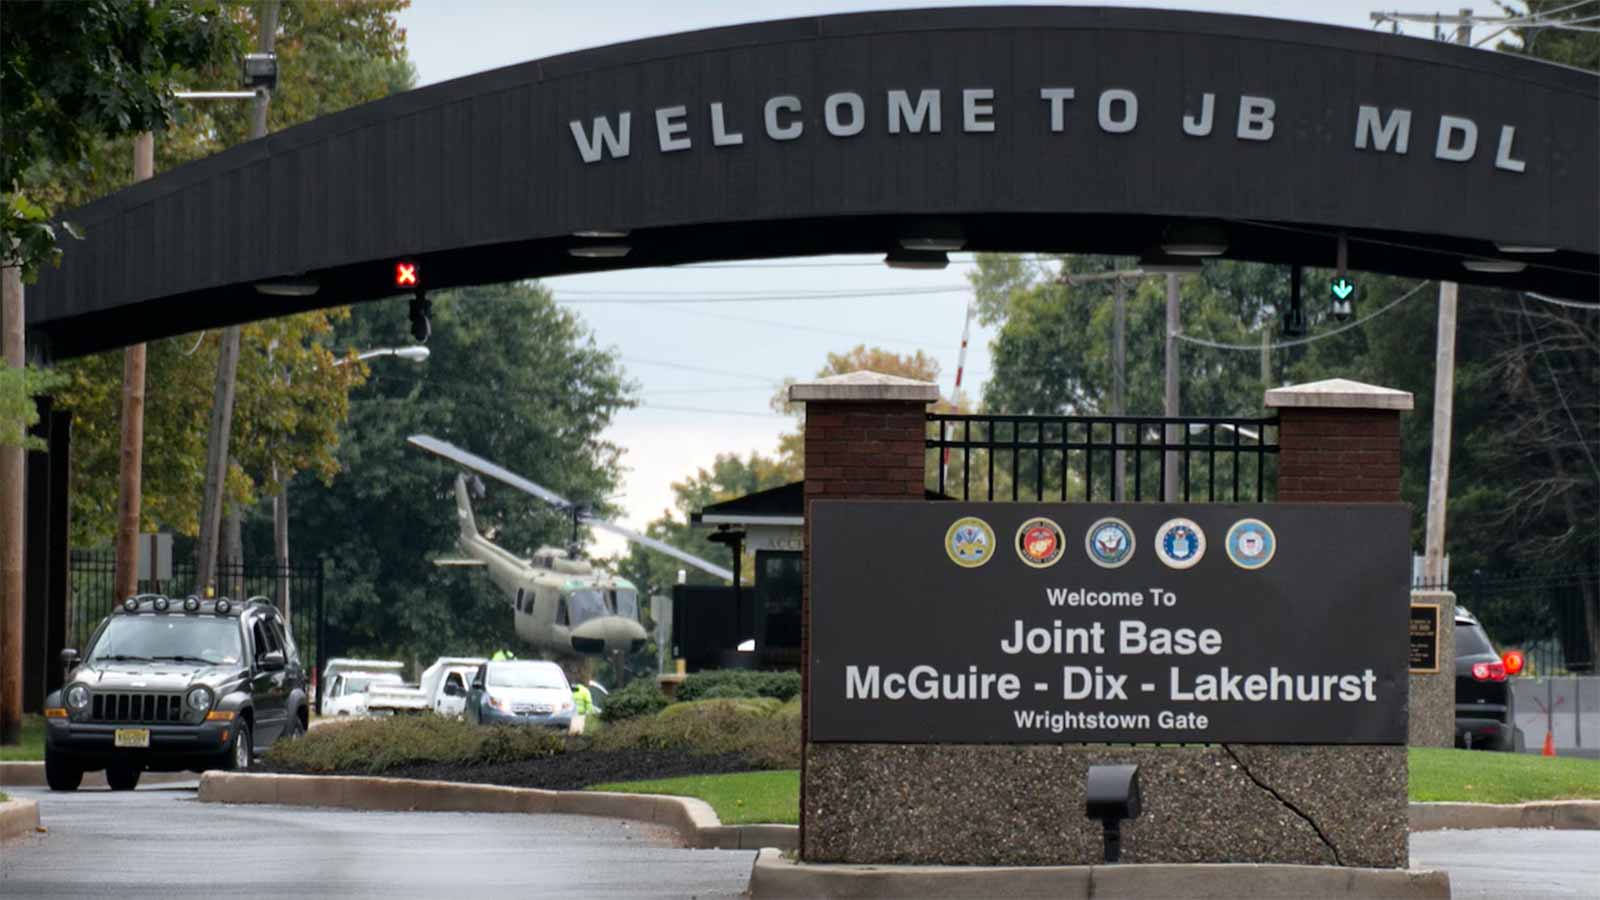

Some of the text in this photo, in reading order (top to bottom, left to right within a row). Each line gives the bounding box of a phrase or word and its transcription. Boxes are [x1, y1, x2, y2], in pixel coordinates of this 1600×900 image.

[570, 88, 1526, 172] WELCOME TO JB MDL
[1047, 588, 1177, 606] Welcome To
[1001, 620, 1222, 654] Joint Base
[846, 665, 1021, 700] McGuire
[1063, 666, 1128, 700] Dix
[1170, 667, 1377, 701] Lakehurst
[1014, 711, 1209, 733] Wrightstown Gate
